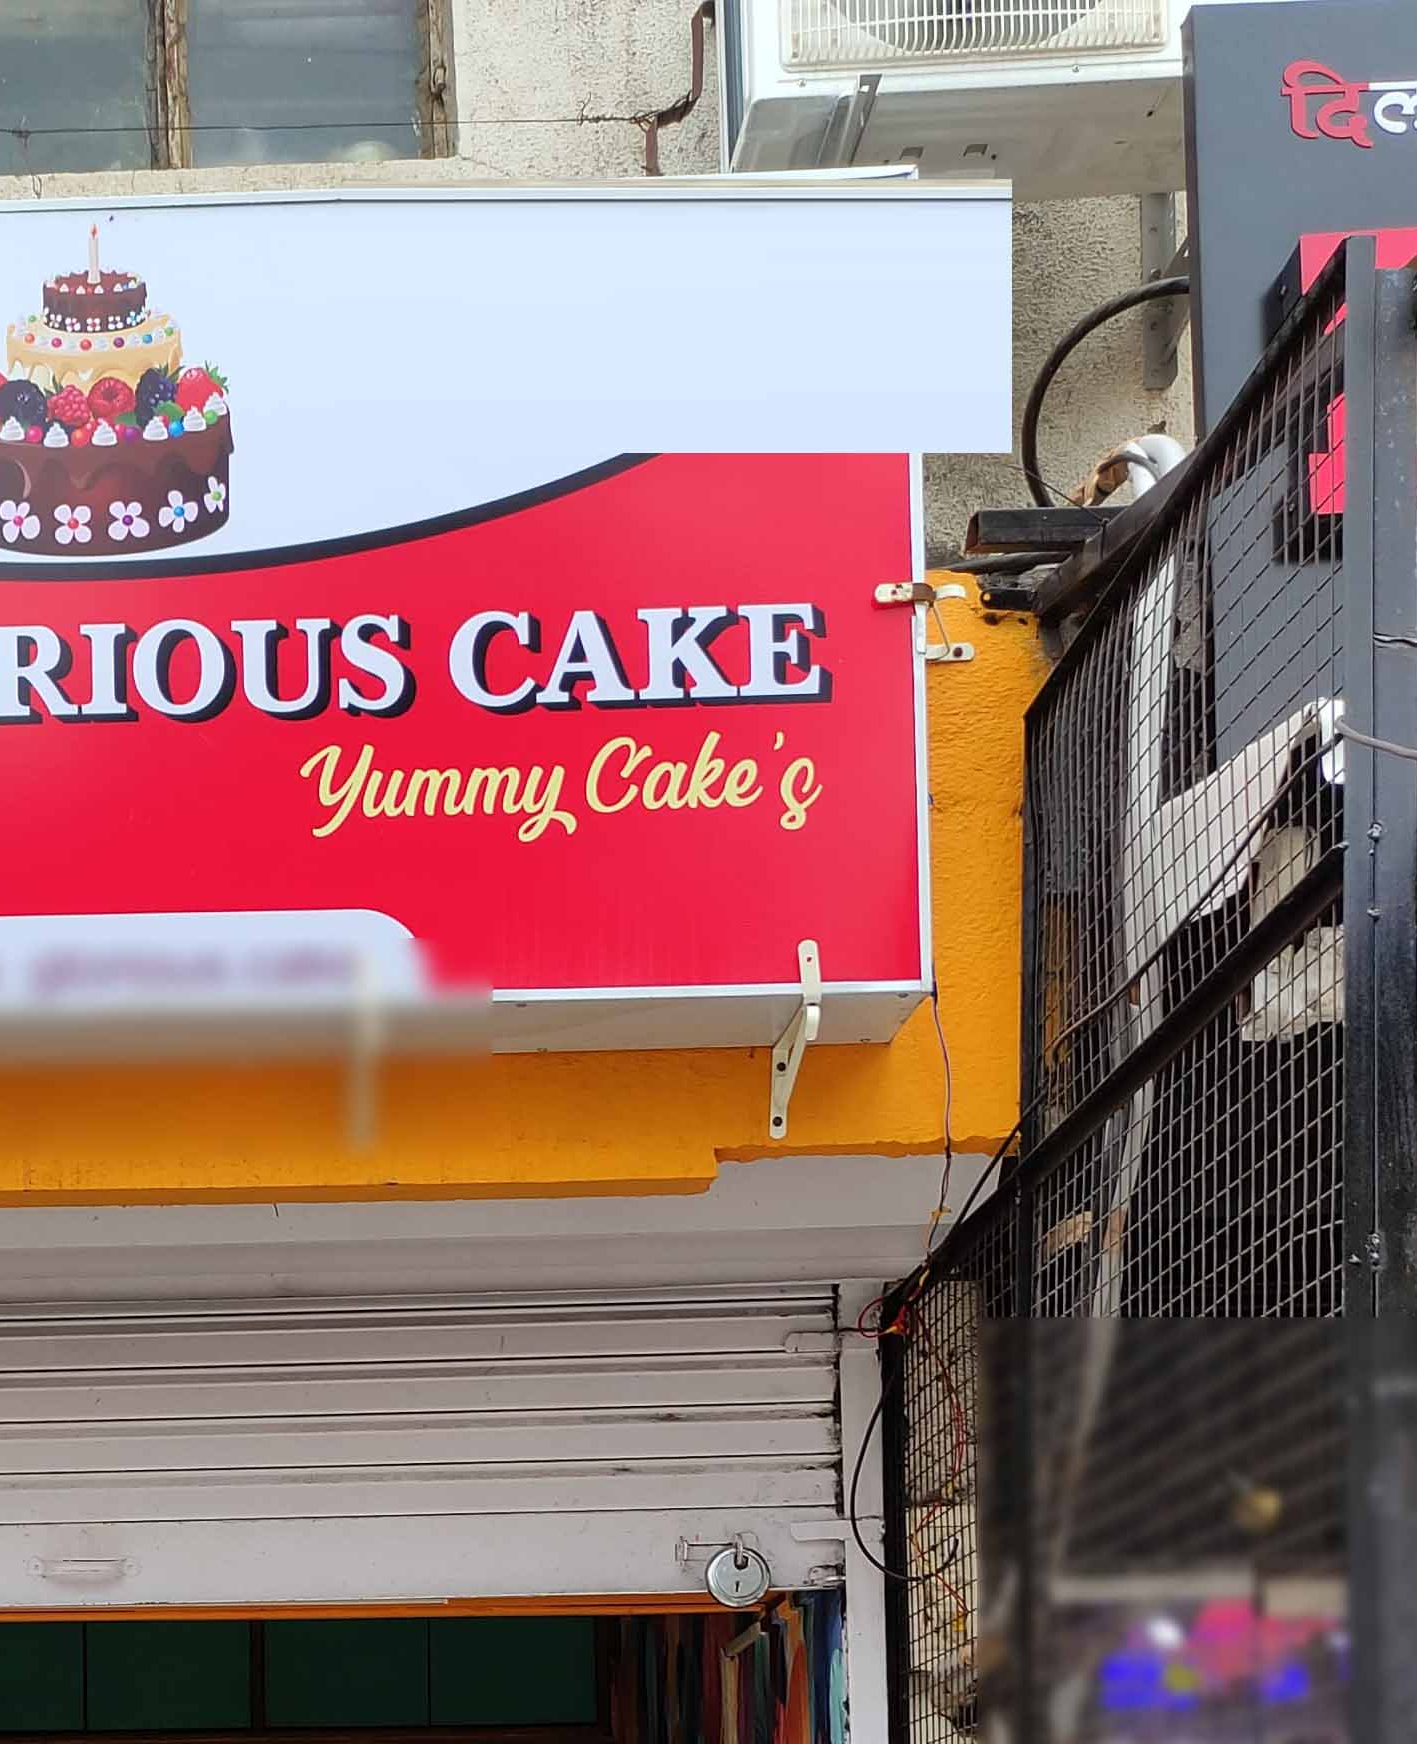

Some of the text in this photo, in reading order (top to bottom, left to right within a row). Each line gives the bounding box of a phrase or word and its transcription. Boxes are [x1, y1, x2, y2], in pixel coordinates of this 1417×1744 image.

[447, 602, 832, 715] CAKE
[299, 731, 823, 843] Yummy Cake's
